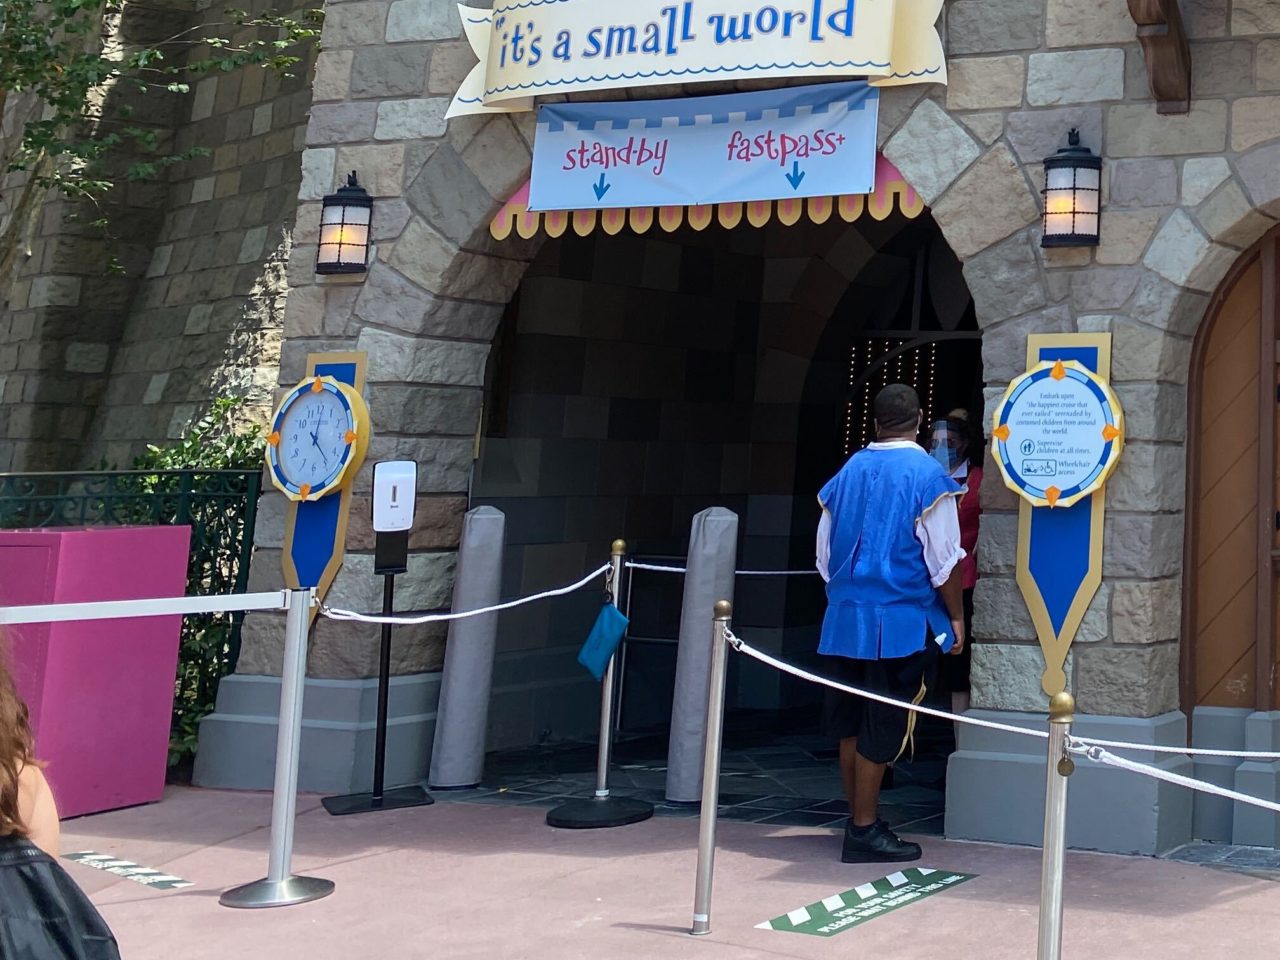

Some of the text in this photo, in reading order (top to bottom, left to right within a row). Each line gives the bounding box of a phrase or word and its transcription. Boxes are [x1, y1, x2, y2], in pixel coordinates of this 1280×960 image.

[494, 16, 543, 68] "it's
[551, 31, 572, 62] a
[582, 0, 699, 60] small
[562, 136, 669, 176] stand-by
[727, 126, 847, 167] fastpass+
[1037, 402, 1060, 410] happiest
[1084, 410, 1092, 419] by
[1042, 427, 1051, 435] the
[1036, 439, 1063, 448] Supervise
[1058, 460, 1091, 468] Wheelchair
[833, 883, 921, 918] FOR YOUR SAFETY
[816, 915, 862, 933] PLEASE
[854, 904, 888, 917] WAIT
